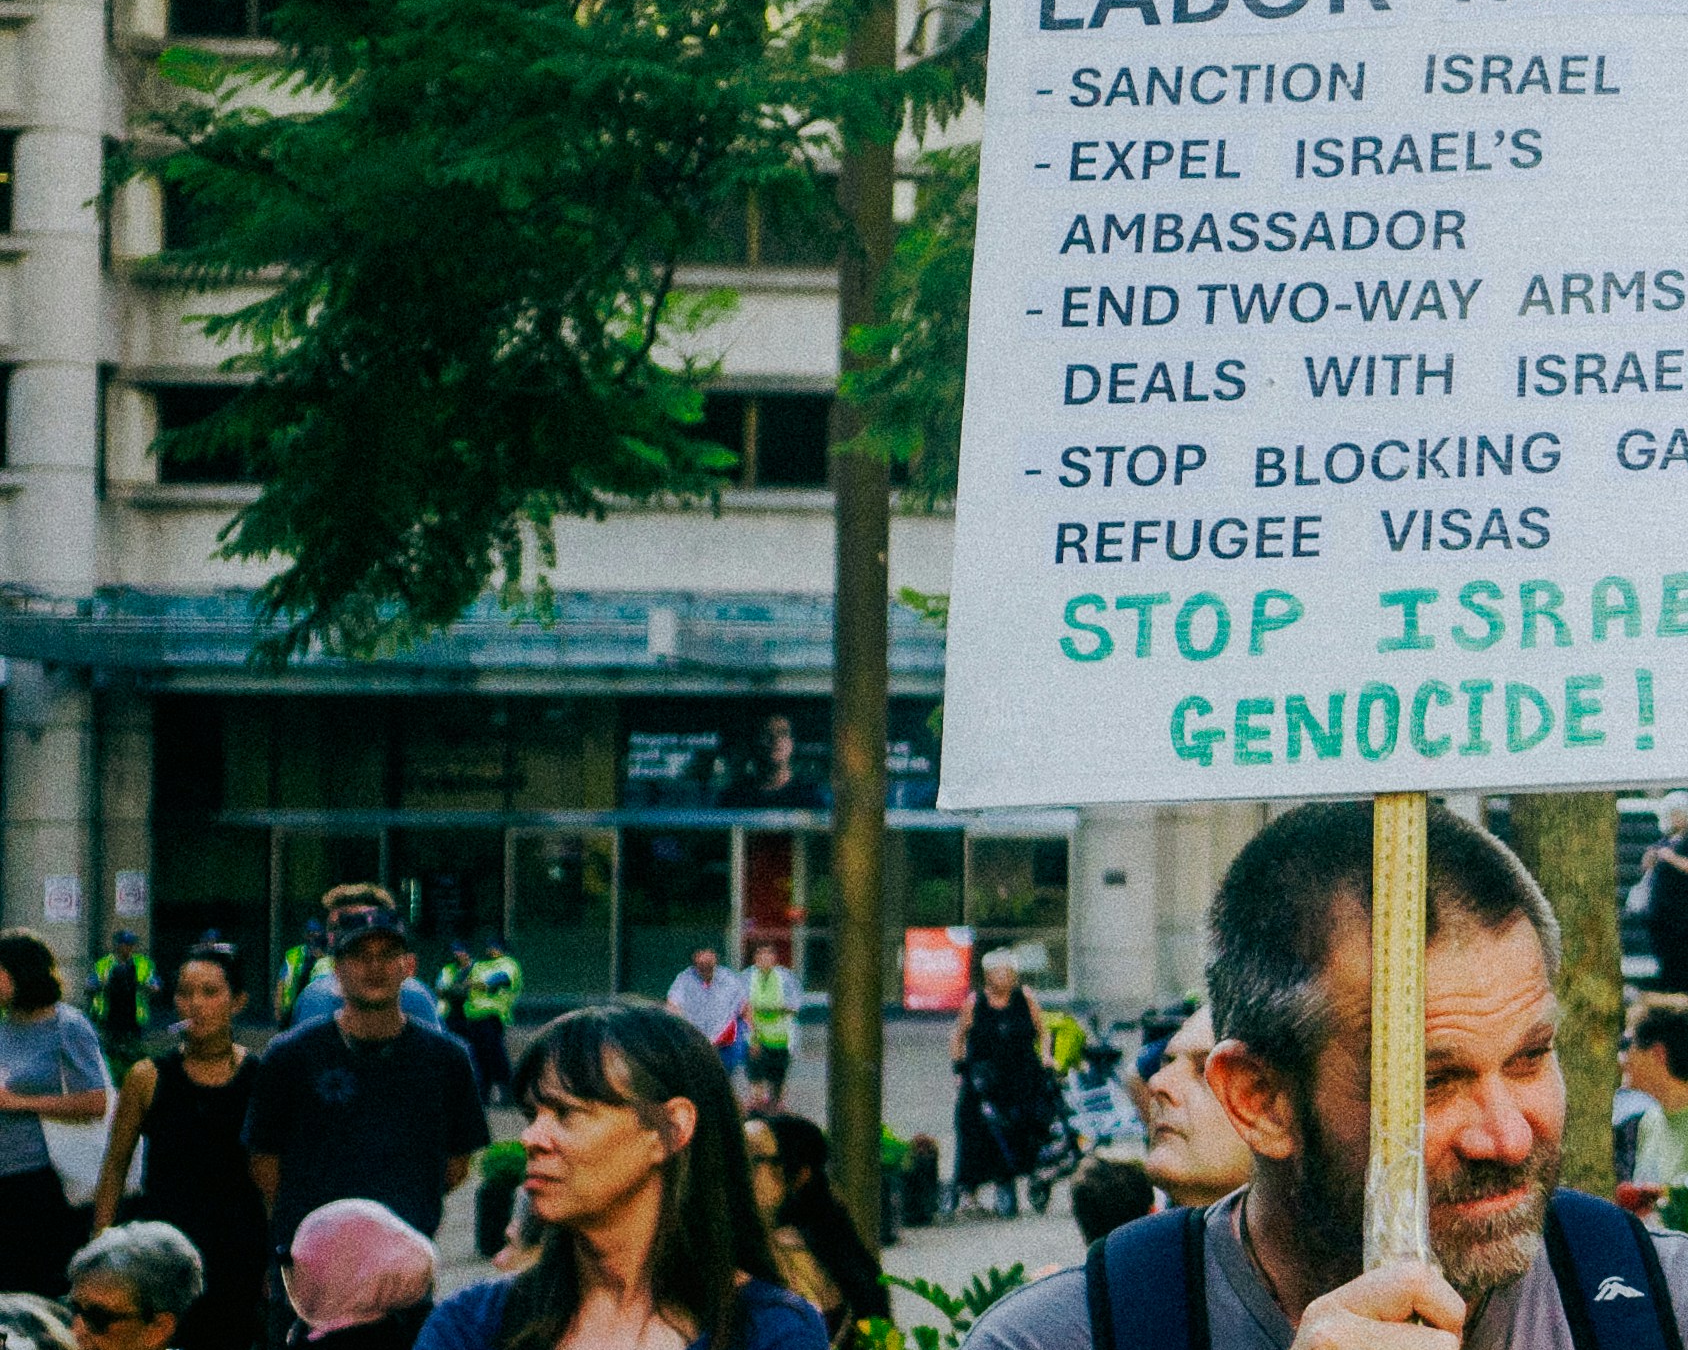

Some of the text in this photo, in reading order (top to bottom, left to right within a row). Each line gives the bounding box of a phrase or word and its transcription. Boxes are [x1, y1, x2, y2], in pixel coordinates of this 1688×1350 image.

[1424, 54, 1621, 96] ISRAEL
[1294, 128, 1545, 179] ISRAEL'S
[1060, 210, 1467, 255] AMBASSADOR
[1199, 278, 1483, 324] TWO-WAY
[1518, 269, 1688, 317] ARMS
[1063, 359, 1249, 406] DEALS
[1304, 354, 1456, 398] WITH
[1255, 431, 1563, 488] BLOCKING
[1053, 506, 1552, 564] REFUGEE VISAS
[1059, 590, 1305, 662] STOP
[1170, 669, 1656, 767] GENOCIDE!
